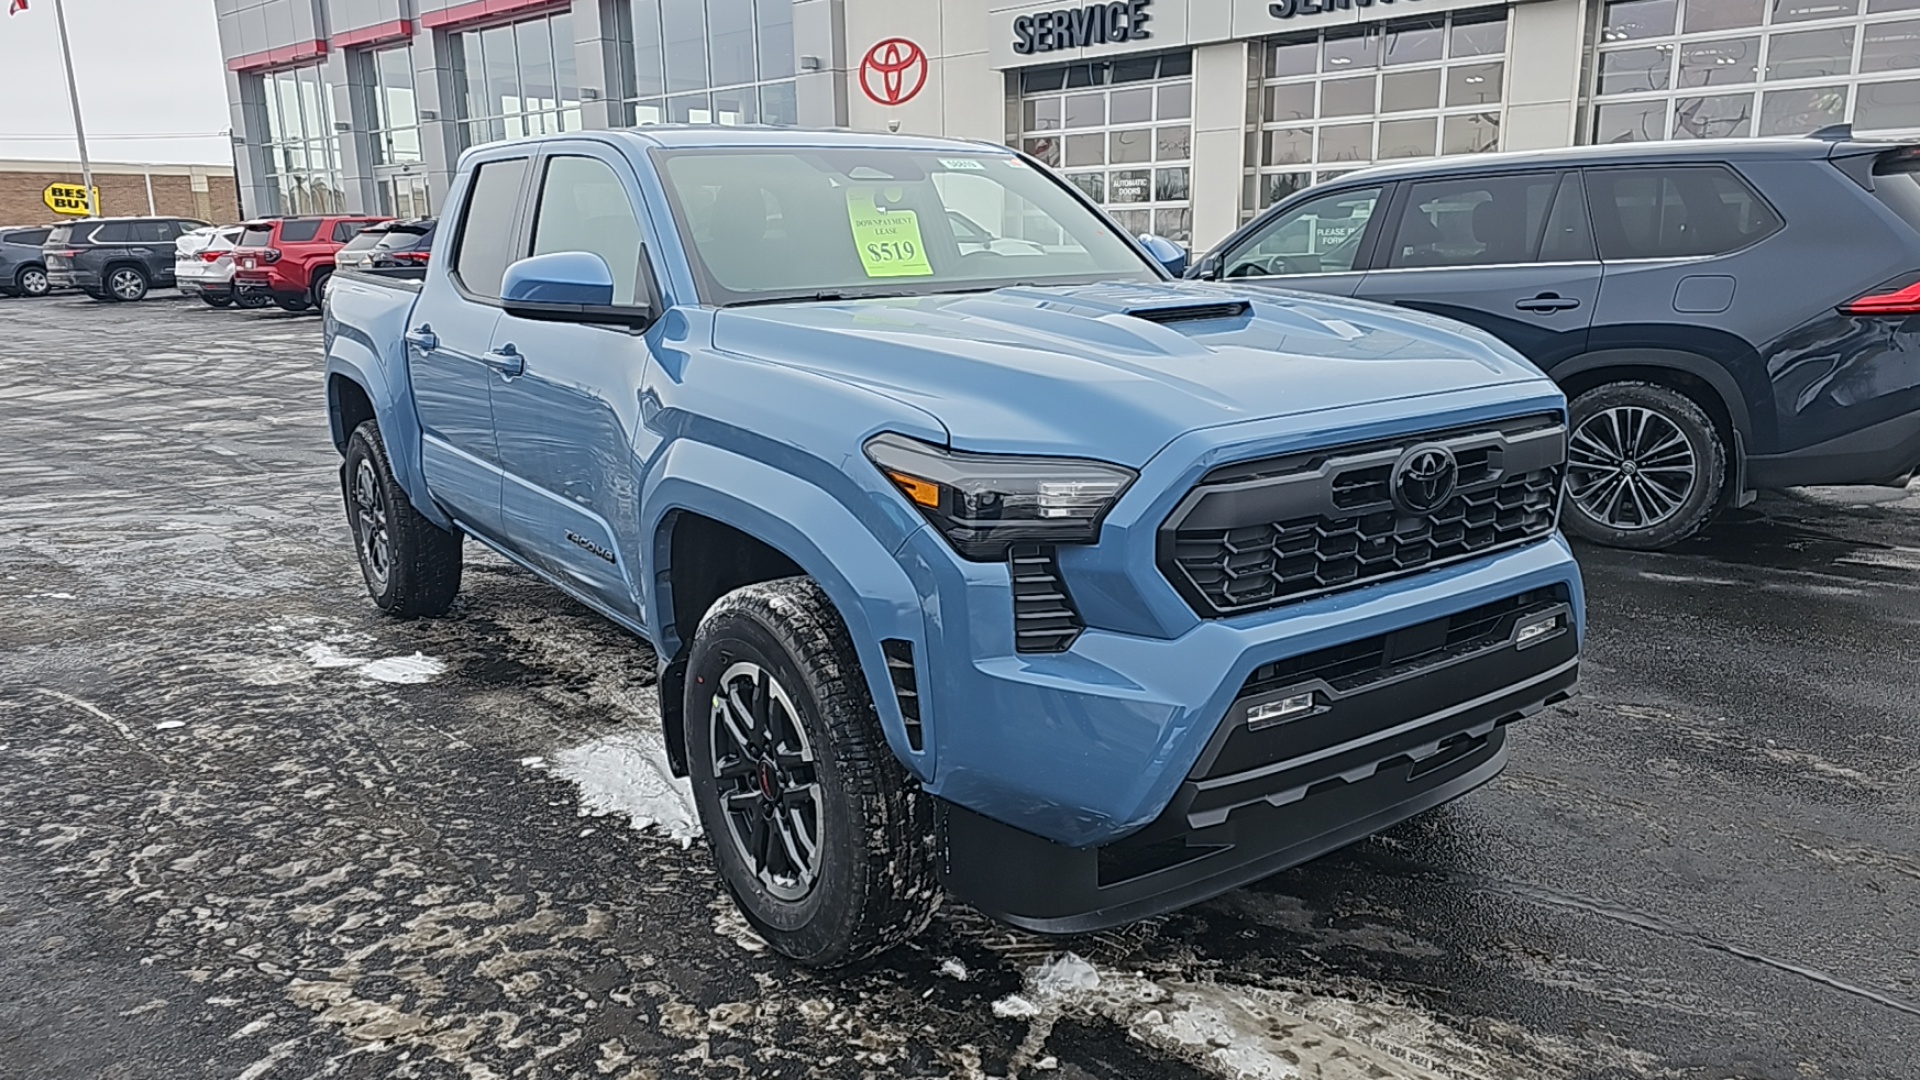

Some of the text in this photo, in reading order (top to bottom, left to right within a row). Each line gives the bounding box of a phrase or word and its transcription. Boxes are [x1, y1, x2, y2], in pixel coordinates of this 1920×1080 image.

[1013, 0, 1153, 54] SERVICE
[1113, 179, 1148, 188] AUTOMATIC
[1118, 187, 1141, 195] DOORS
[54, 198, 89, 209] BUY
[856, 217, 912, 227] DOWNPAYMENT
[1317, 228, 1345, 236] PLEASE
[867, 241, 915, 262] $519
[564, 528, 616, 564] TACOMA
